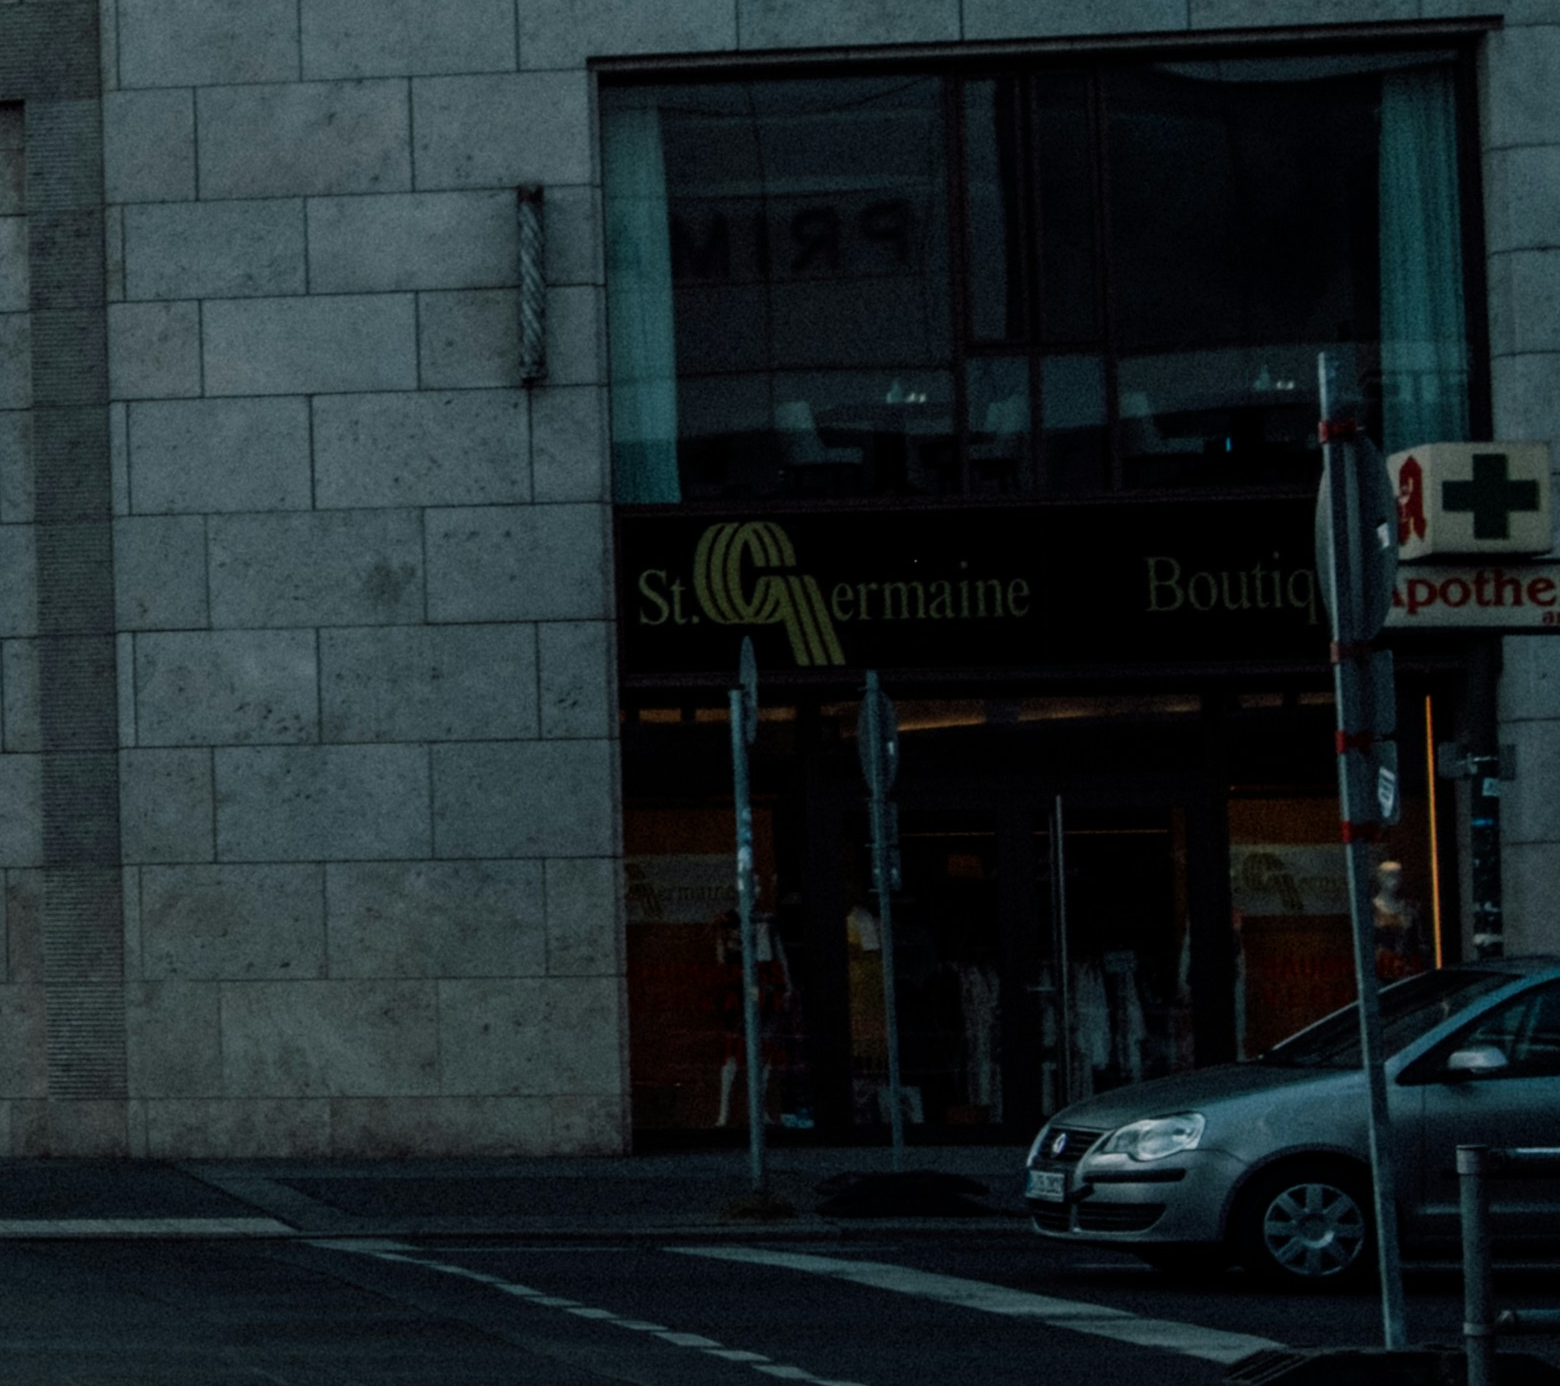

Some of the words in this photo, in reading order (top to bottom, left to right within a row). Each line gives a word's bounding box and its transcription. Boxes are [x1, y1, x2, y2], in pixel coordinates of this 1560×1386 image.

[636, 568, 700, 626] St.
[692, 521, 1032, 667] Germaine
[1144, 553, 1323, 626] Boutiq
